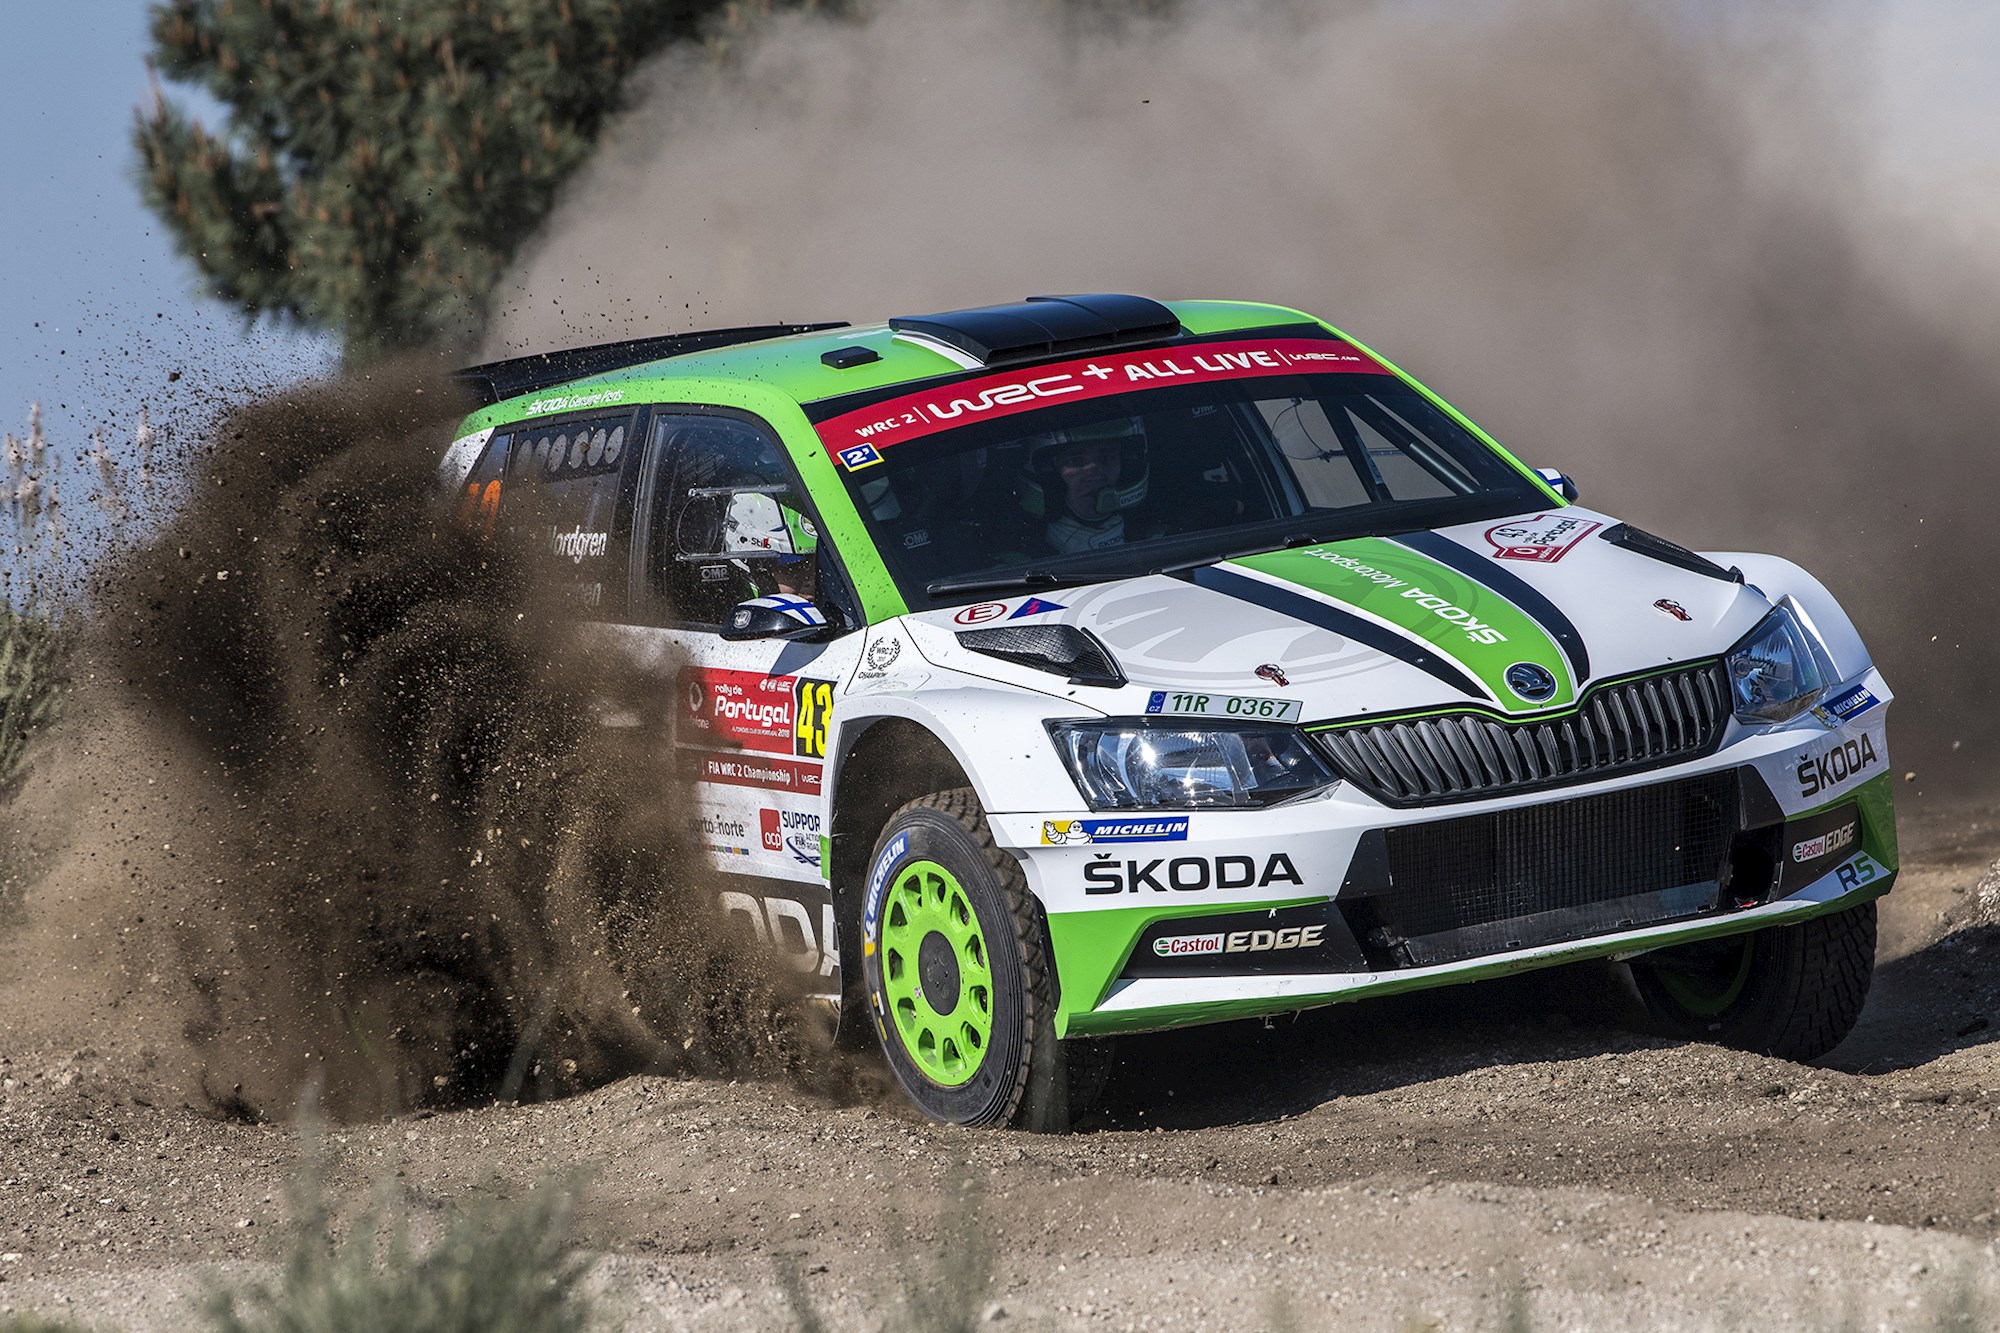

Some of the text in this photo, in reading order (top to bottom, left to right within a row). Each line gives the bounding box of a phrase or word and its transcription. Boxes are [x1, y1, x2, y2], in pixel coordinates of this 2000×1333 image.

[1124, 359, 1195, 382] ALL
[1193, 351, 1280, 372] LIVE
[855, 413, 917, 438] WRC 2
[1302, 548, 1508, 645] ŠKODA Motorsport
[968, 605, 993, 621] E
[715, 684, 743, 696] rally de
[1832, 688, 1872, 714] MICHELIN
[714, 695, 790, 727] Portugal
[797, 682, 834, 757] 43
[1172, 694, 1291, 718] 11R 0367
[708, 761, 791, 785] FIA WRC 2 Championship
[1796, 732, 1877, 798] ŠKODA
[1094, 821, 1188, 835] MICHELIN
[1801, 821, 1855, 859] Castrol EDGE
[866, 836, 905, 918] MICHELIN
[1083, 852, 1304, 895] ŠKODA
[1835, 855, 1876, 892] R5
[1169, 923, 1328, 954] Castrol EDGE
